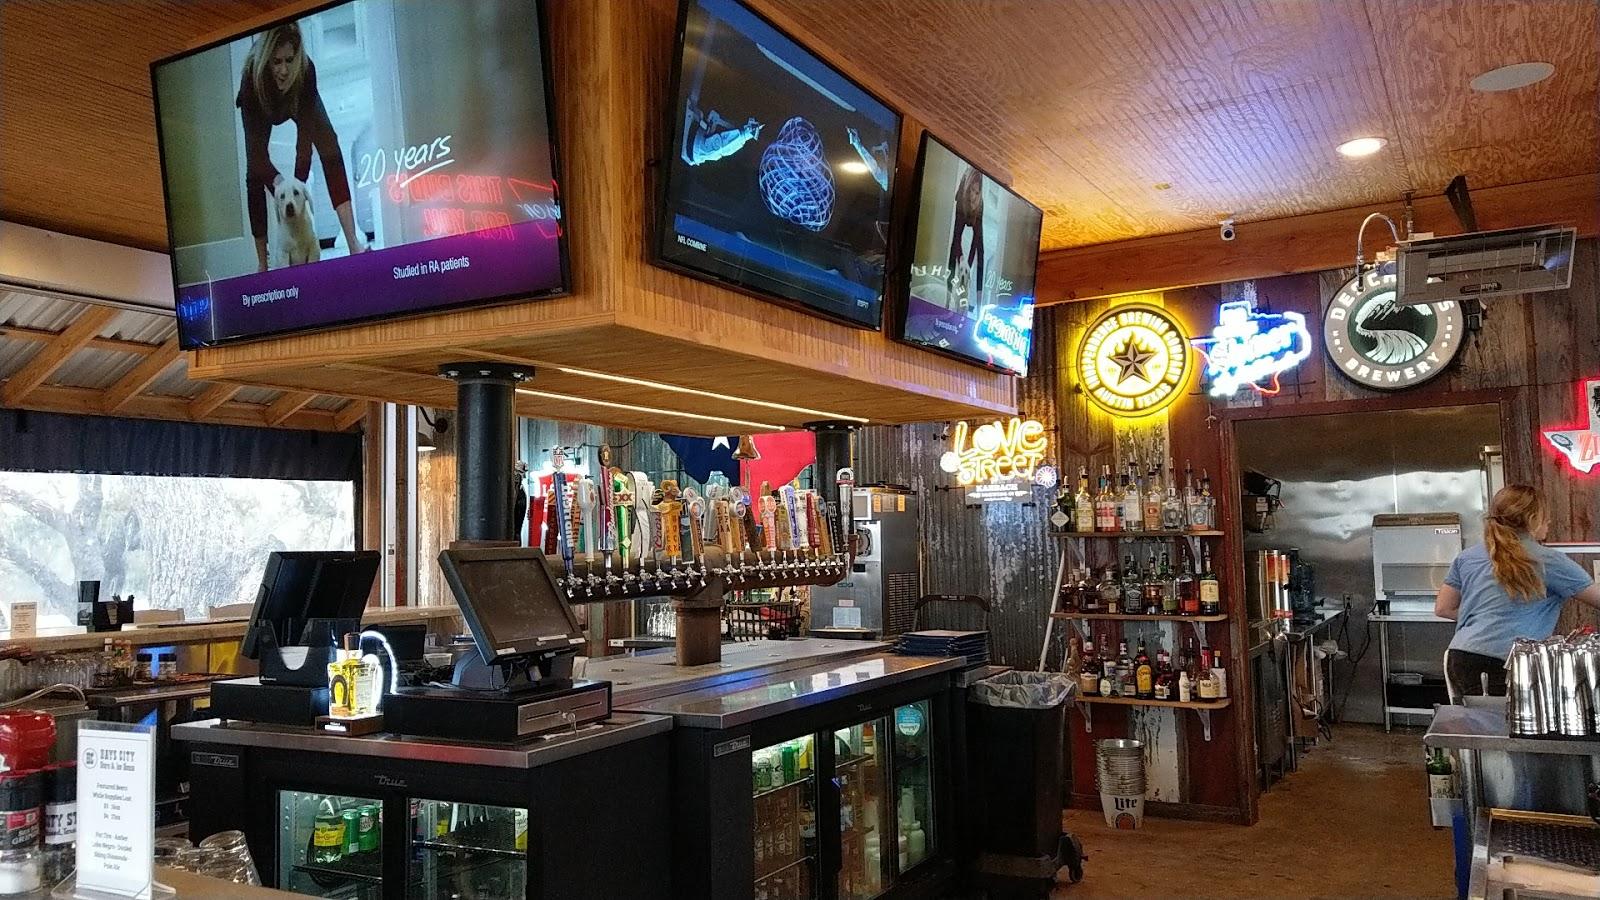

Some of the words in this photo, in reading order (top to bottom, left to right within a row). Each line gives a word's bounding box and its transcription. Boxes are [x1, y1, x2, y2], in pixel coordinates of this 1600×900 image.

[357, 149, 386, 188] 20
[394, 135, 452, 182] years
[393, 262, 420, 279] Studied
[420, 263, 428, 274] in
[428, 260, 440, 274] RA
[441, 255, 470, 274] patients
[242, 294, 251, 307] By
[251, 289, 285, 306] prescription
[286, 285, 299, 299] only
[1345, 352, 1440, 382] BREWERY
[119, 750, 135, 762] CITY
[1114, 797, 1138, 811] Lite
[67, 812, 77, 826] ST
